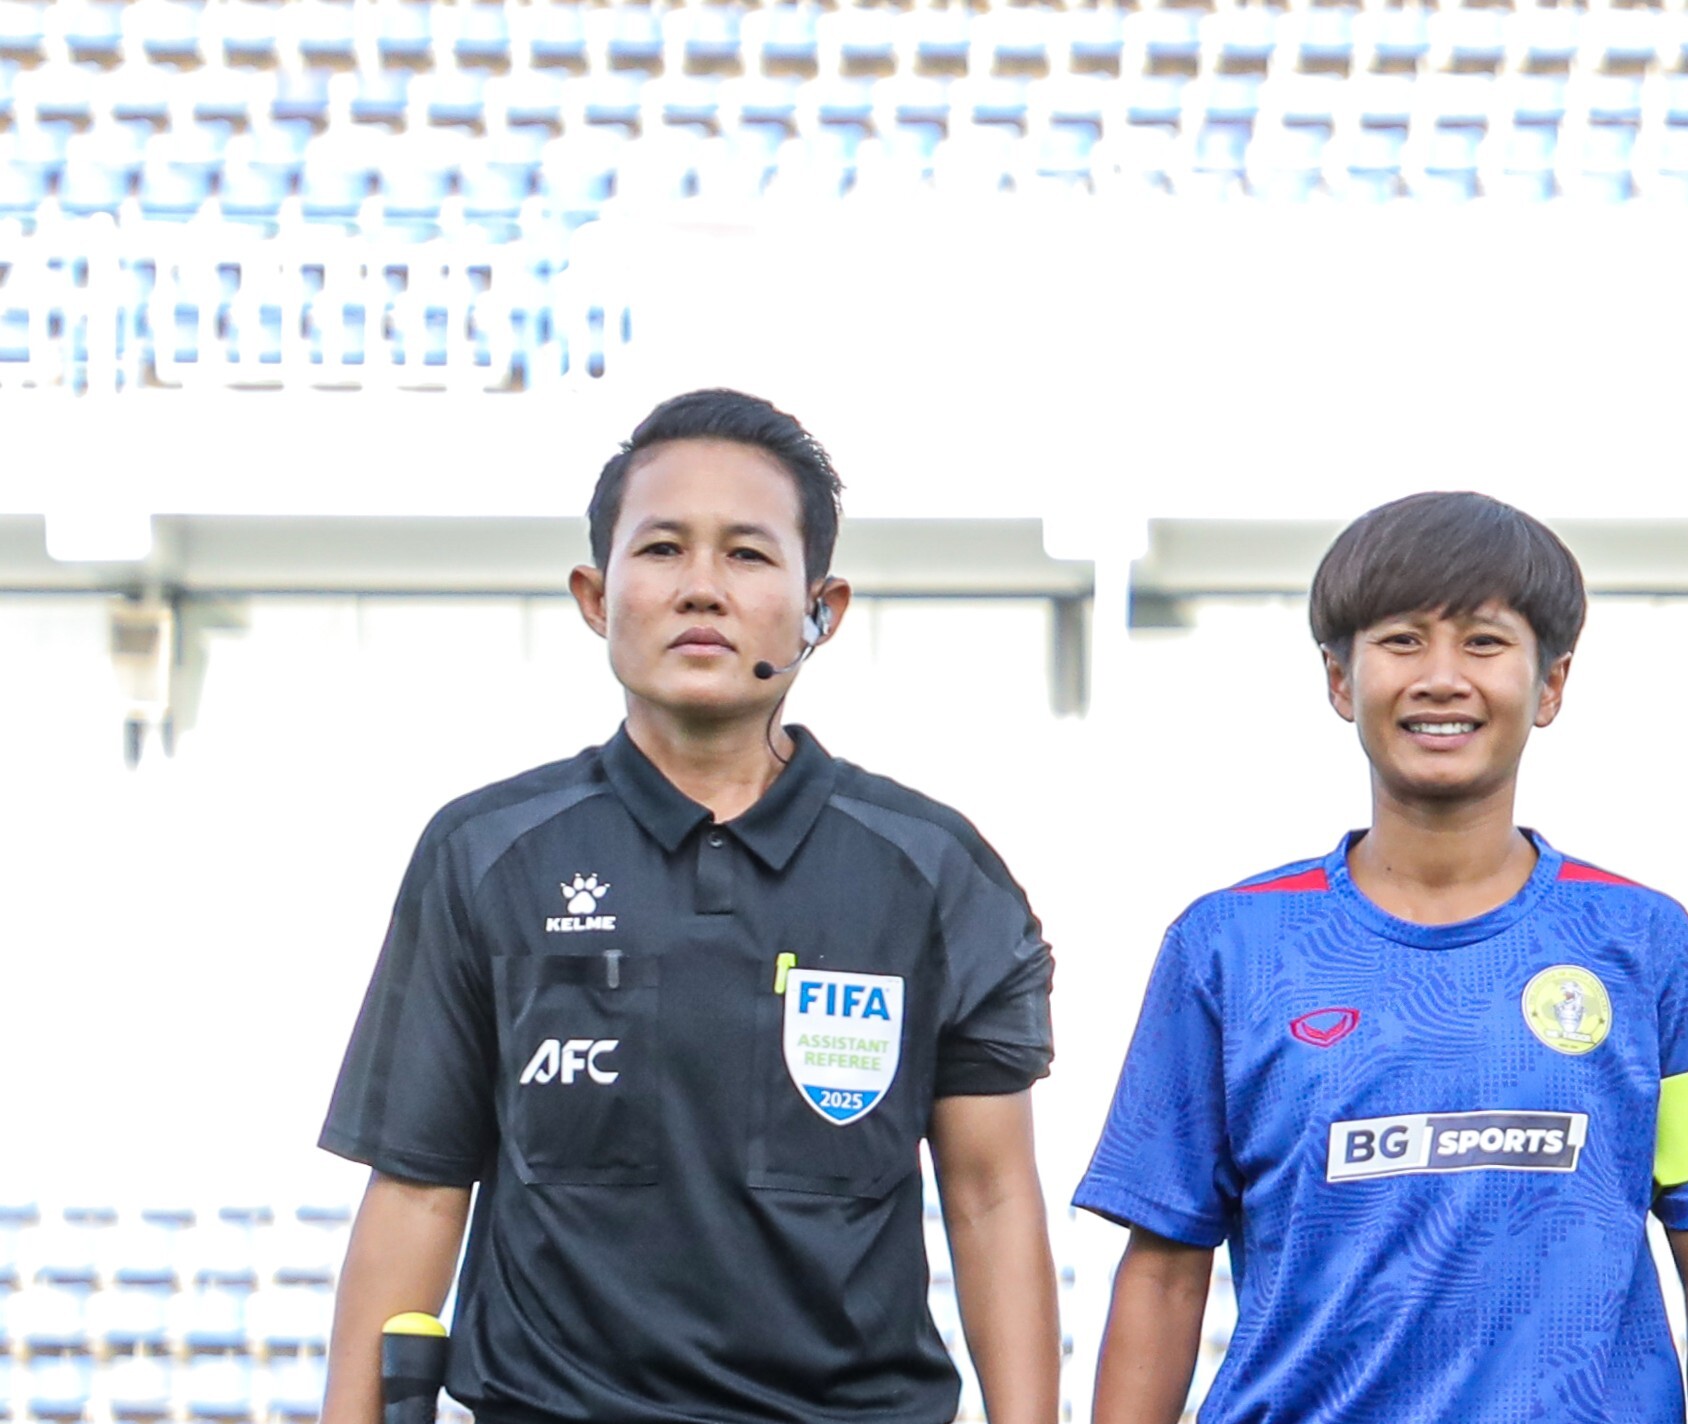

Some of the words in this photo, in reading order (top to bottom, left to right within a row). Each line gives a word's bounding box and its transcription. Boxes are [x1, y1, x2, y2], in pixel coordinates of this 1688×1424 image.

[545, 915, 616, 932] KELME
[798, 981, 891, 1021] FIFA
[797, 1033, 889, 1054] ASSISTANT
[519, 1038, 620, 1085] AFC
[804, 1051, 882, 1071] REFEREE
[819, 1090, 863, 1110] 2025
[1344, 1125, 1409, 1164] BG
[1438, 1127, 1565, 1156] SPORTS
